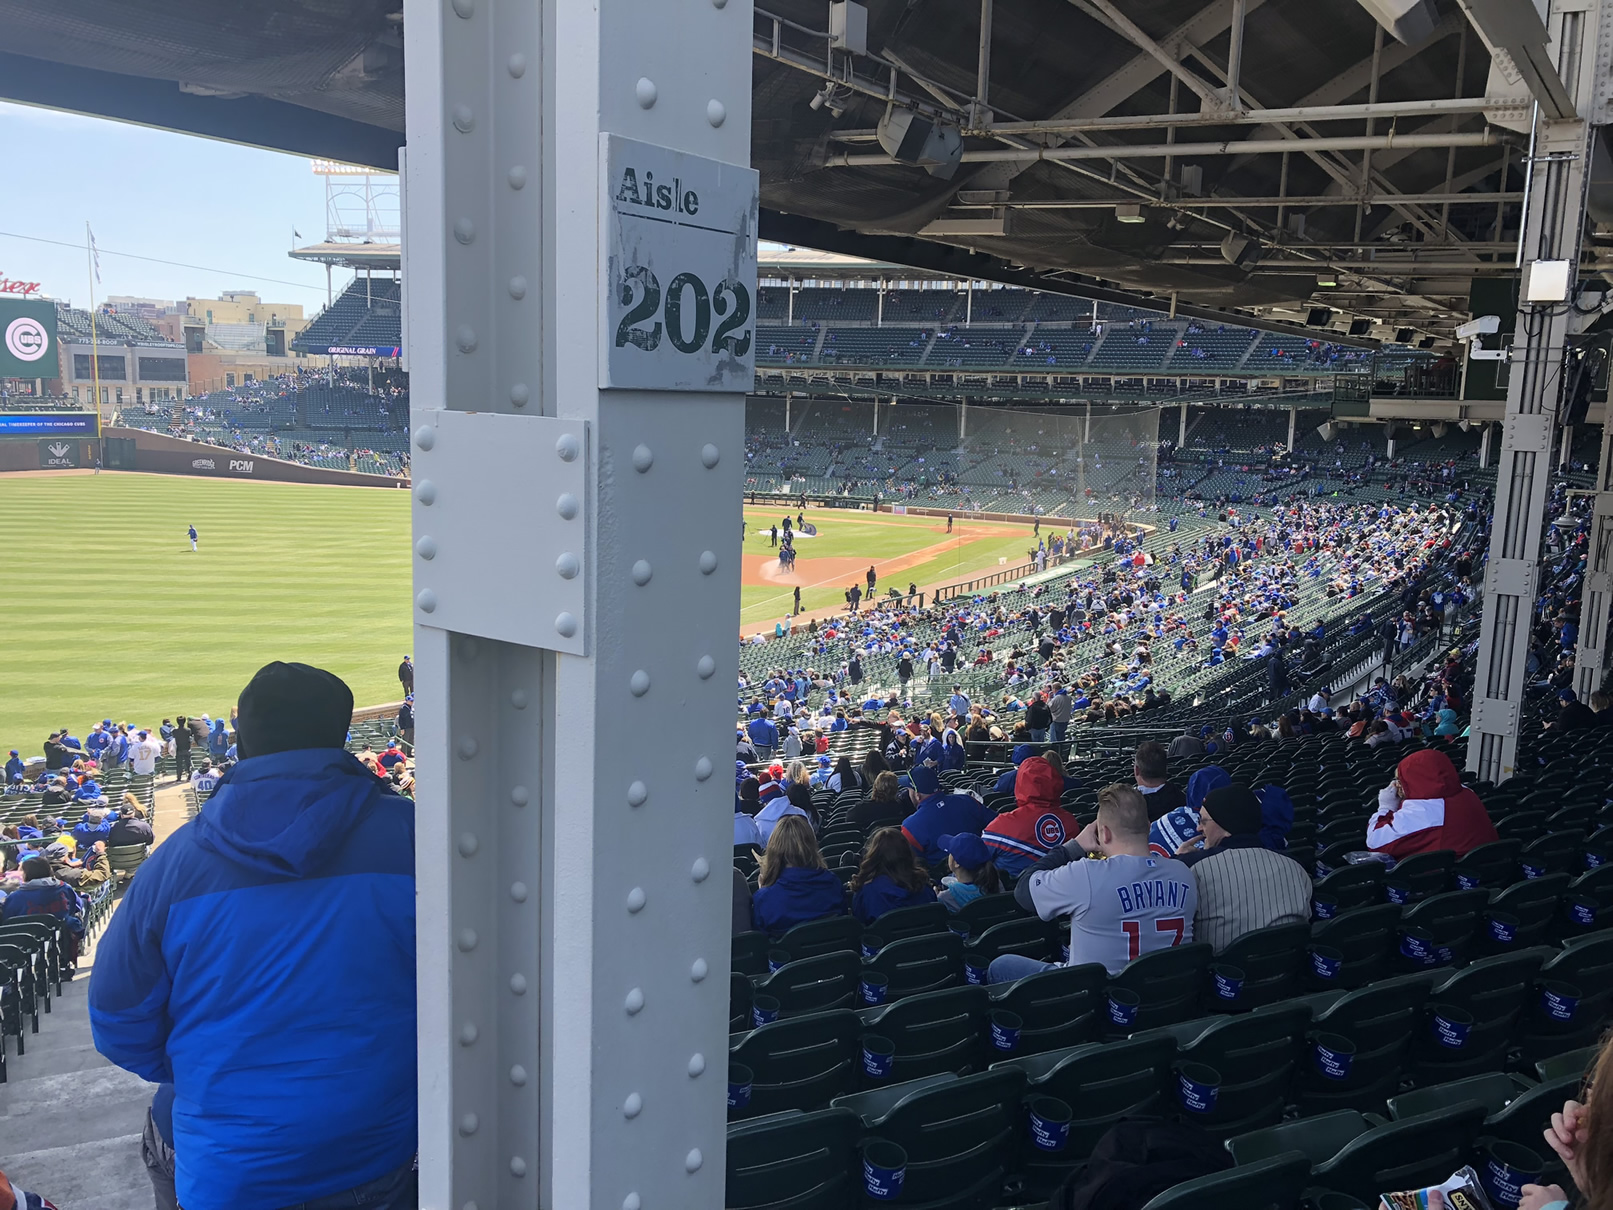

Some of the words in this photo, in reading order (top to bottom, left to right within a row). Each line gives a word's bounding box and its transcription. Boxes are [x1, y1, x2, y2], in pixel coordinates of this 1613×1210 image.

[616, 167, 699, 215] Aisle
[615, 265, 751, 357] 202
[328, 346, 356, 354] ORIGINAL
[357, 347, 377, 355] GRAIN
[48, 458, 72, 466] IDEAL
[229, 459, 254, 471] PCM
[198, 780, 213, 791] 40
[1117, 879, 1191, 914] BRYANT
[1121, 916, 1186, 961] 17
[1493, 1176, 1520, 1194] Hefty
